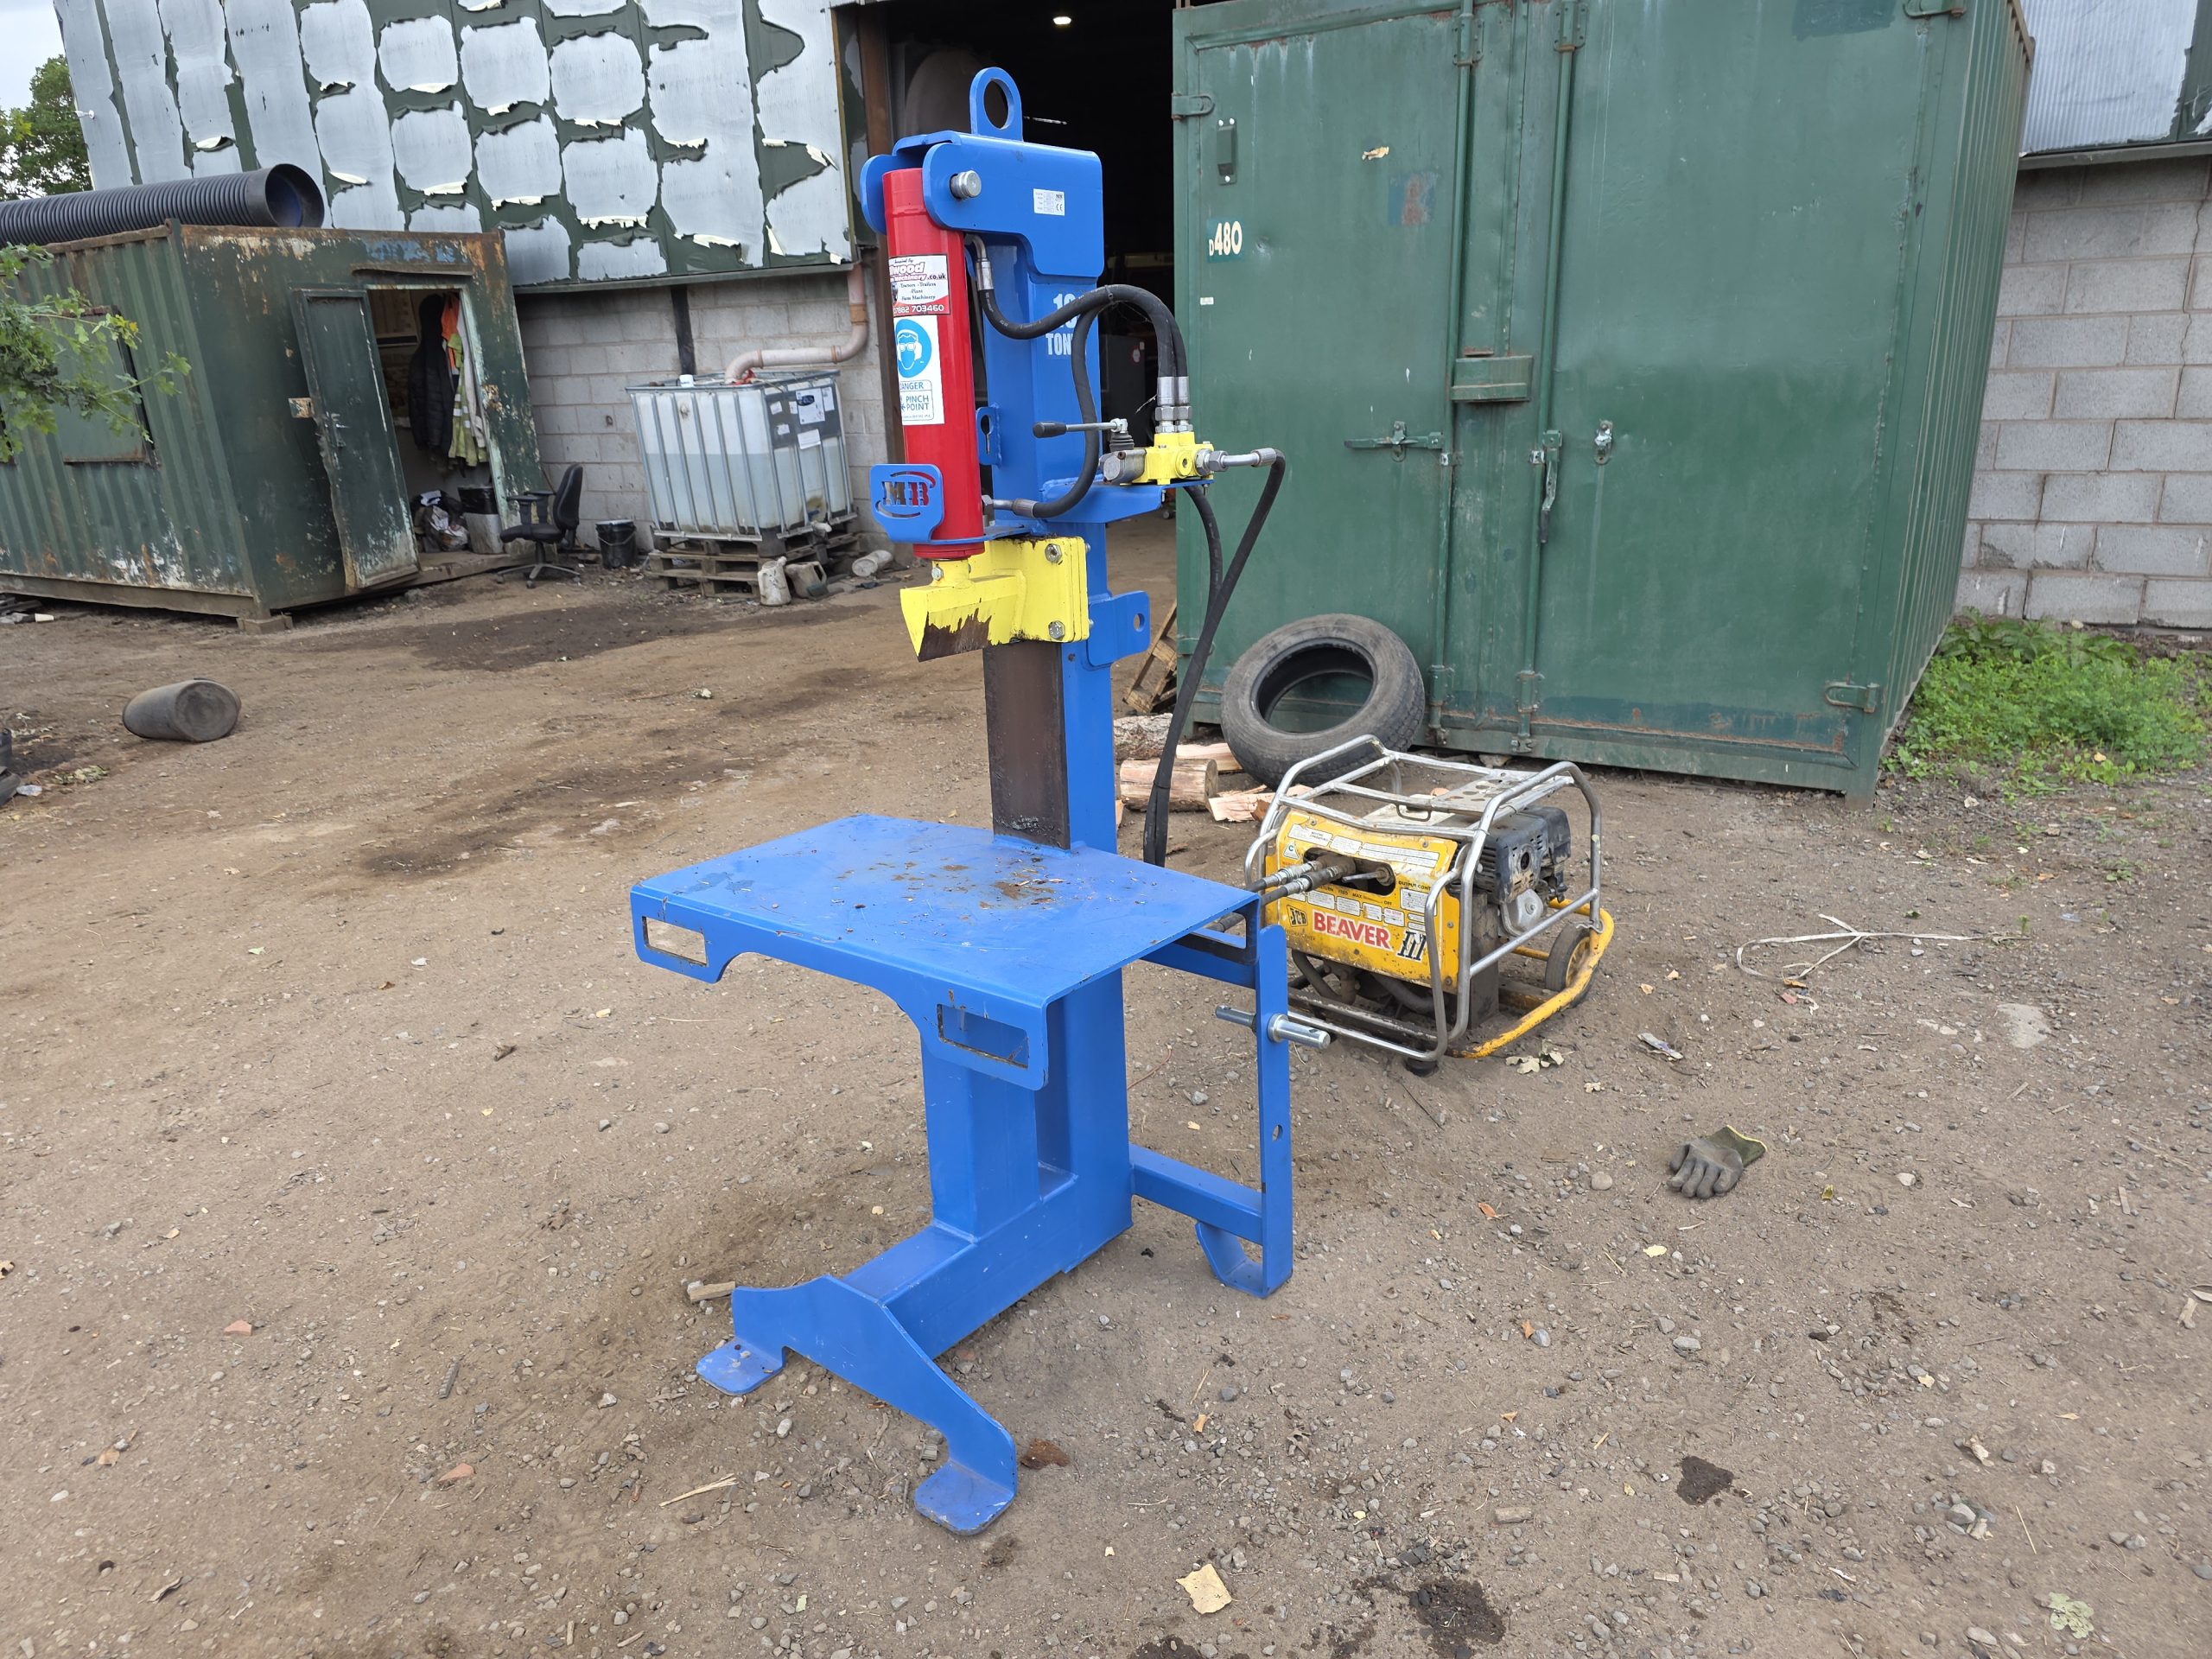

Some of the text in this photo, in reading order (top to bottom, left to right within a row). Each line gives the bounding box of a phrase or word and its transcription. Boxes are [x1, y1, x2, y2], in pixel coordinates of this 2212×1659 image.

[911, 304, 944, 313] 703460
[906, 394, 929, 403] PINCH
[906, 402, 929, 411] POINT
[1289, 907, 1306, 925] JCB
[1313, 912, 1391, 950] BEAVER
